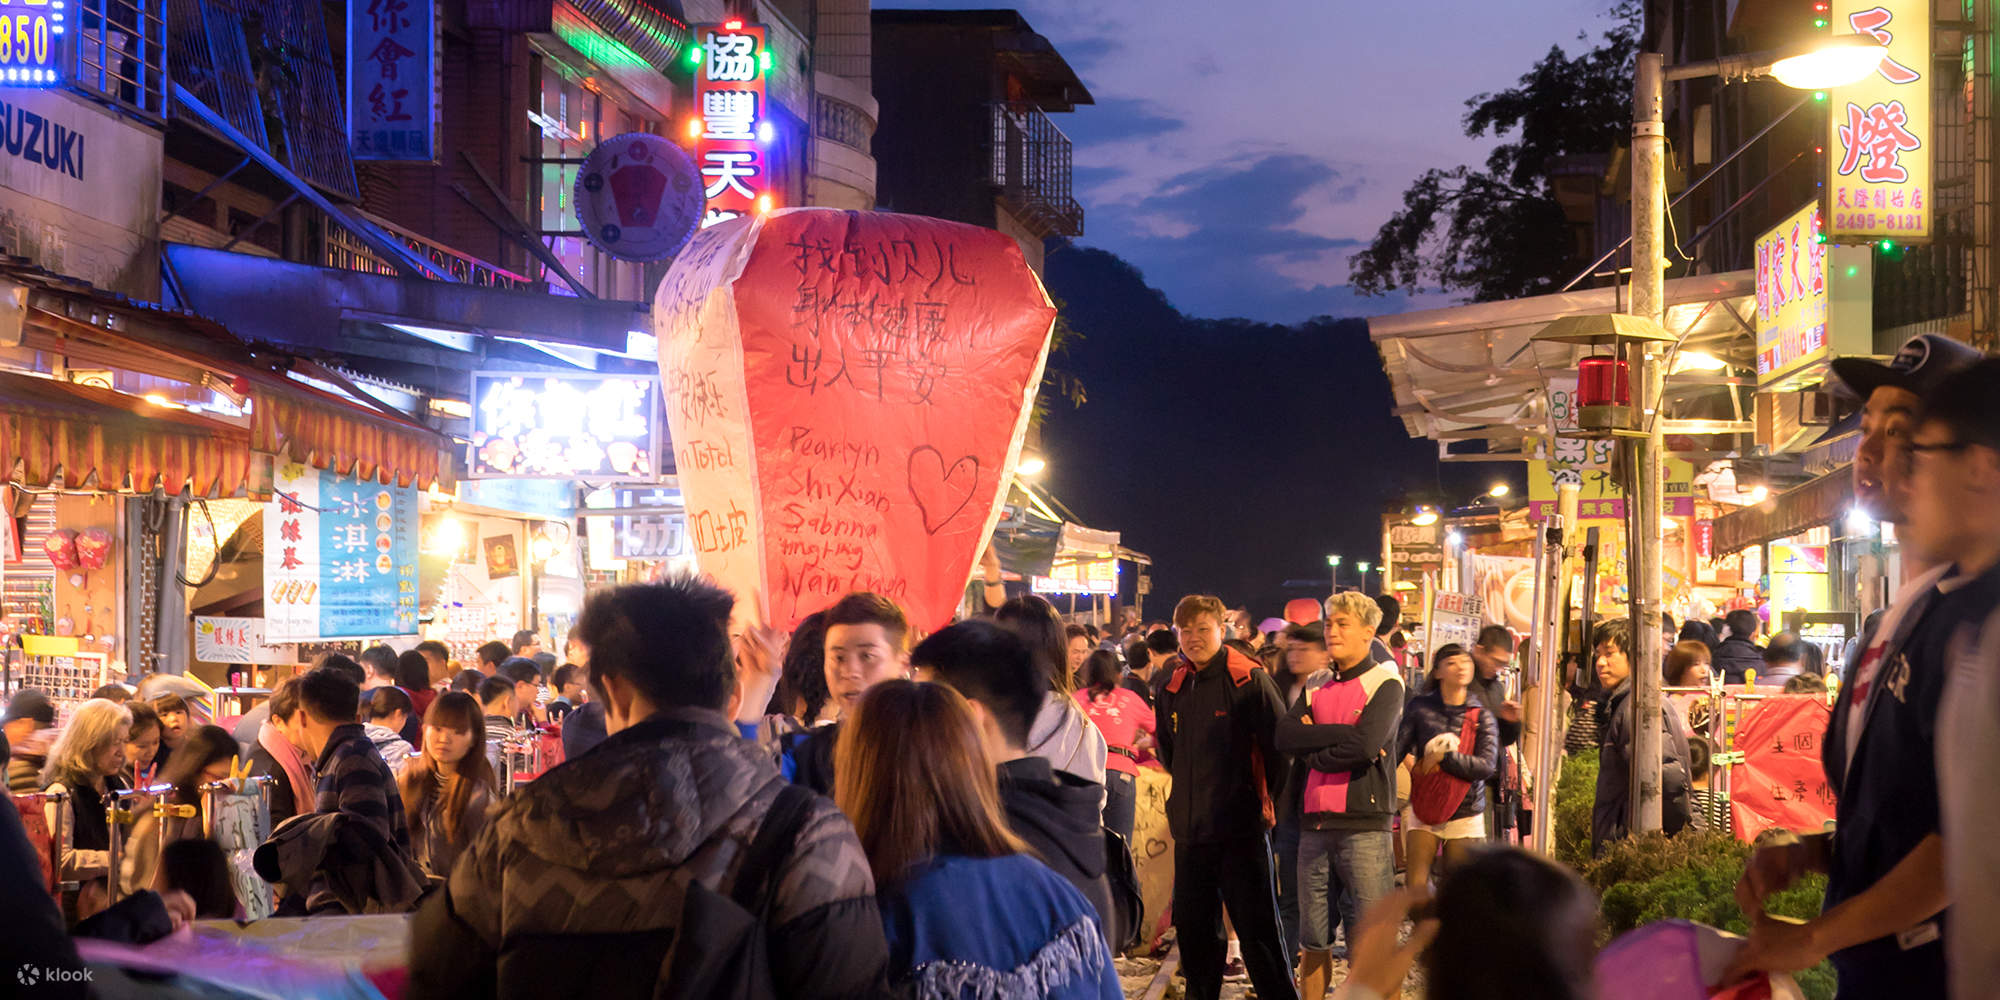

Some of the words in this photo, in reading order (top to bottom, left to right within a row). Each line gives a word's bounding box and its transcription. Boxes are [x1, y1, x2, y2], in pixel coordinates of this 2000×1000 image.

[701, 32, 756, 229] 協豐天
[1836, 187, 1922, 209] 天燈創始店
[1836, 213, 1922, 230] 2495-8131
[332, 491, 370, 584] 冰淇淋
